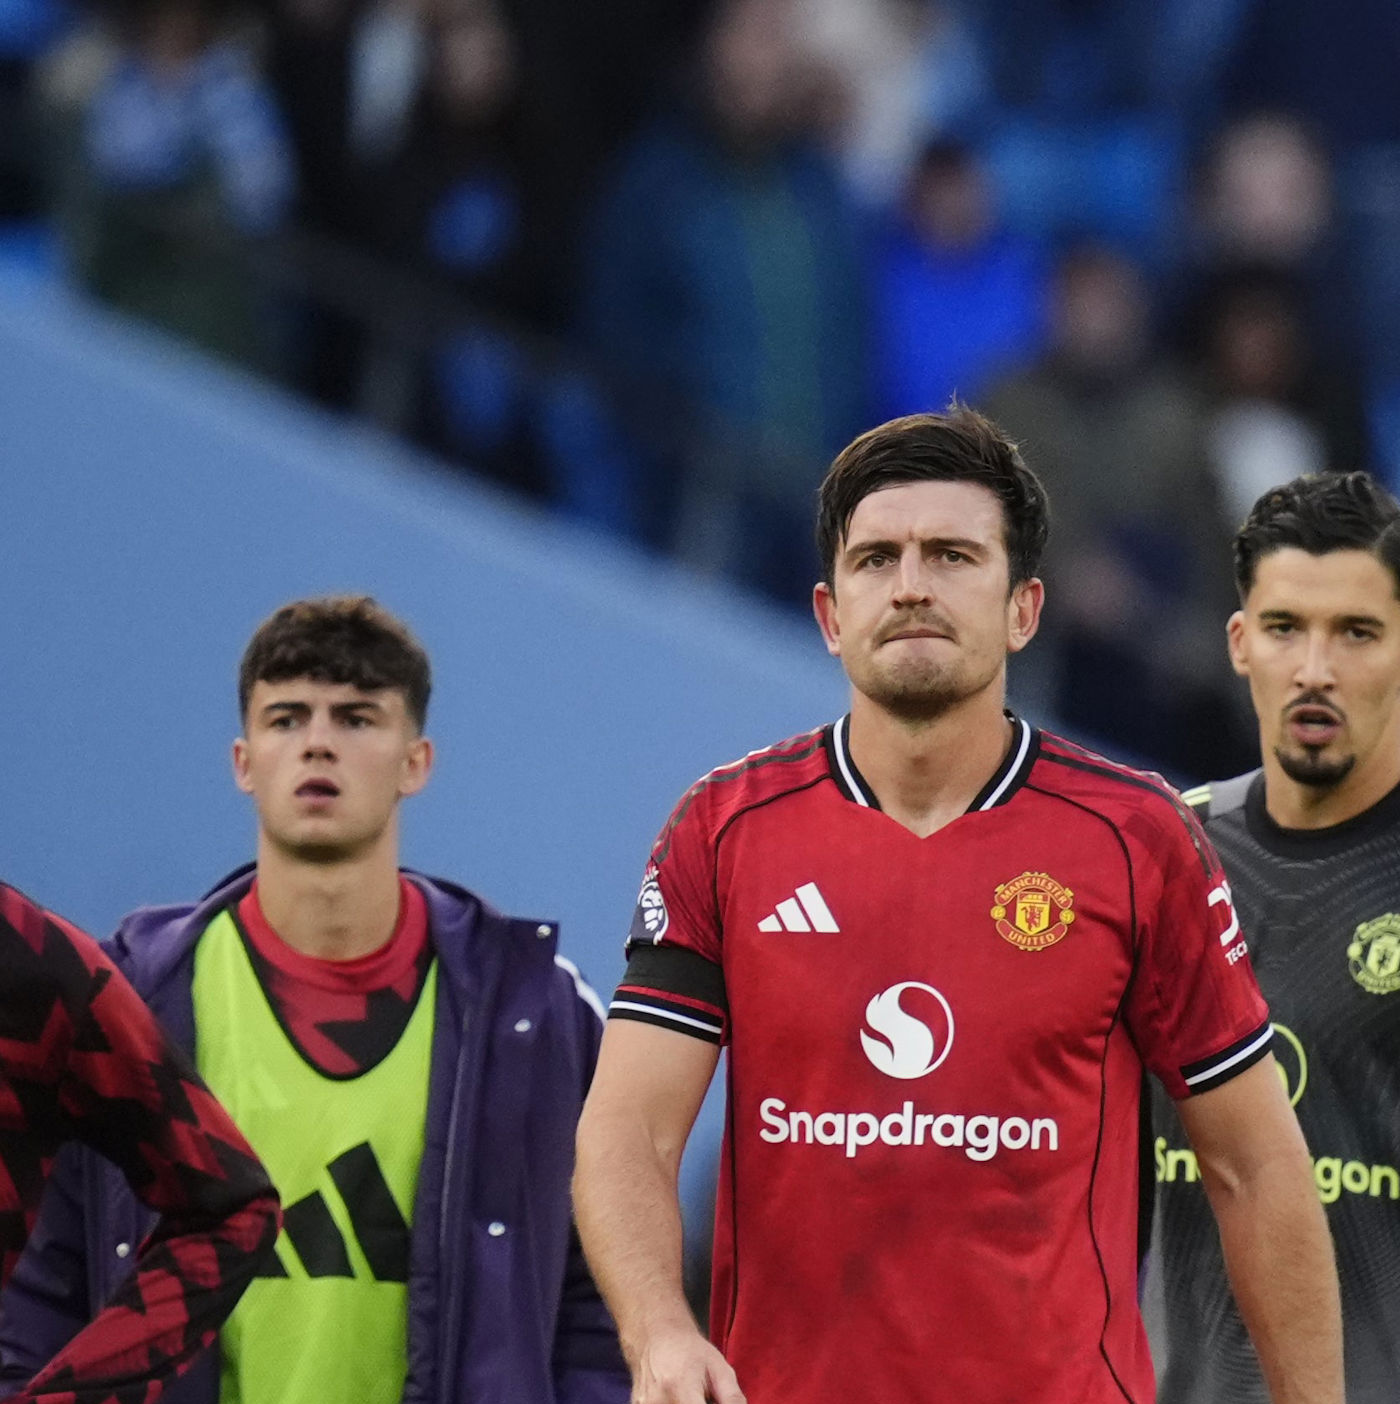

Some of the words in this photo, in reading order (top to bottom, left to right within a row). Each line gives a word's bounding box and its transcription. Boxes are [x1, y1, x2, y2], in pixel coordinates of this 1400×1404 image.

[1001, 877, 1068, 904] MANCHESTER
[1008, 930, 1055, 946] UNITED
[759, 1097, 1059, 1162] Snapdragon
